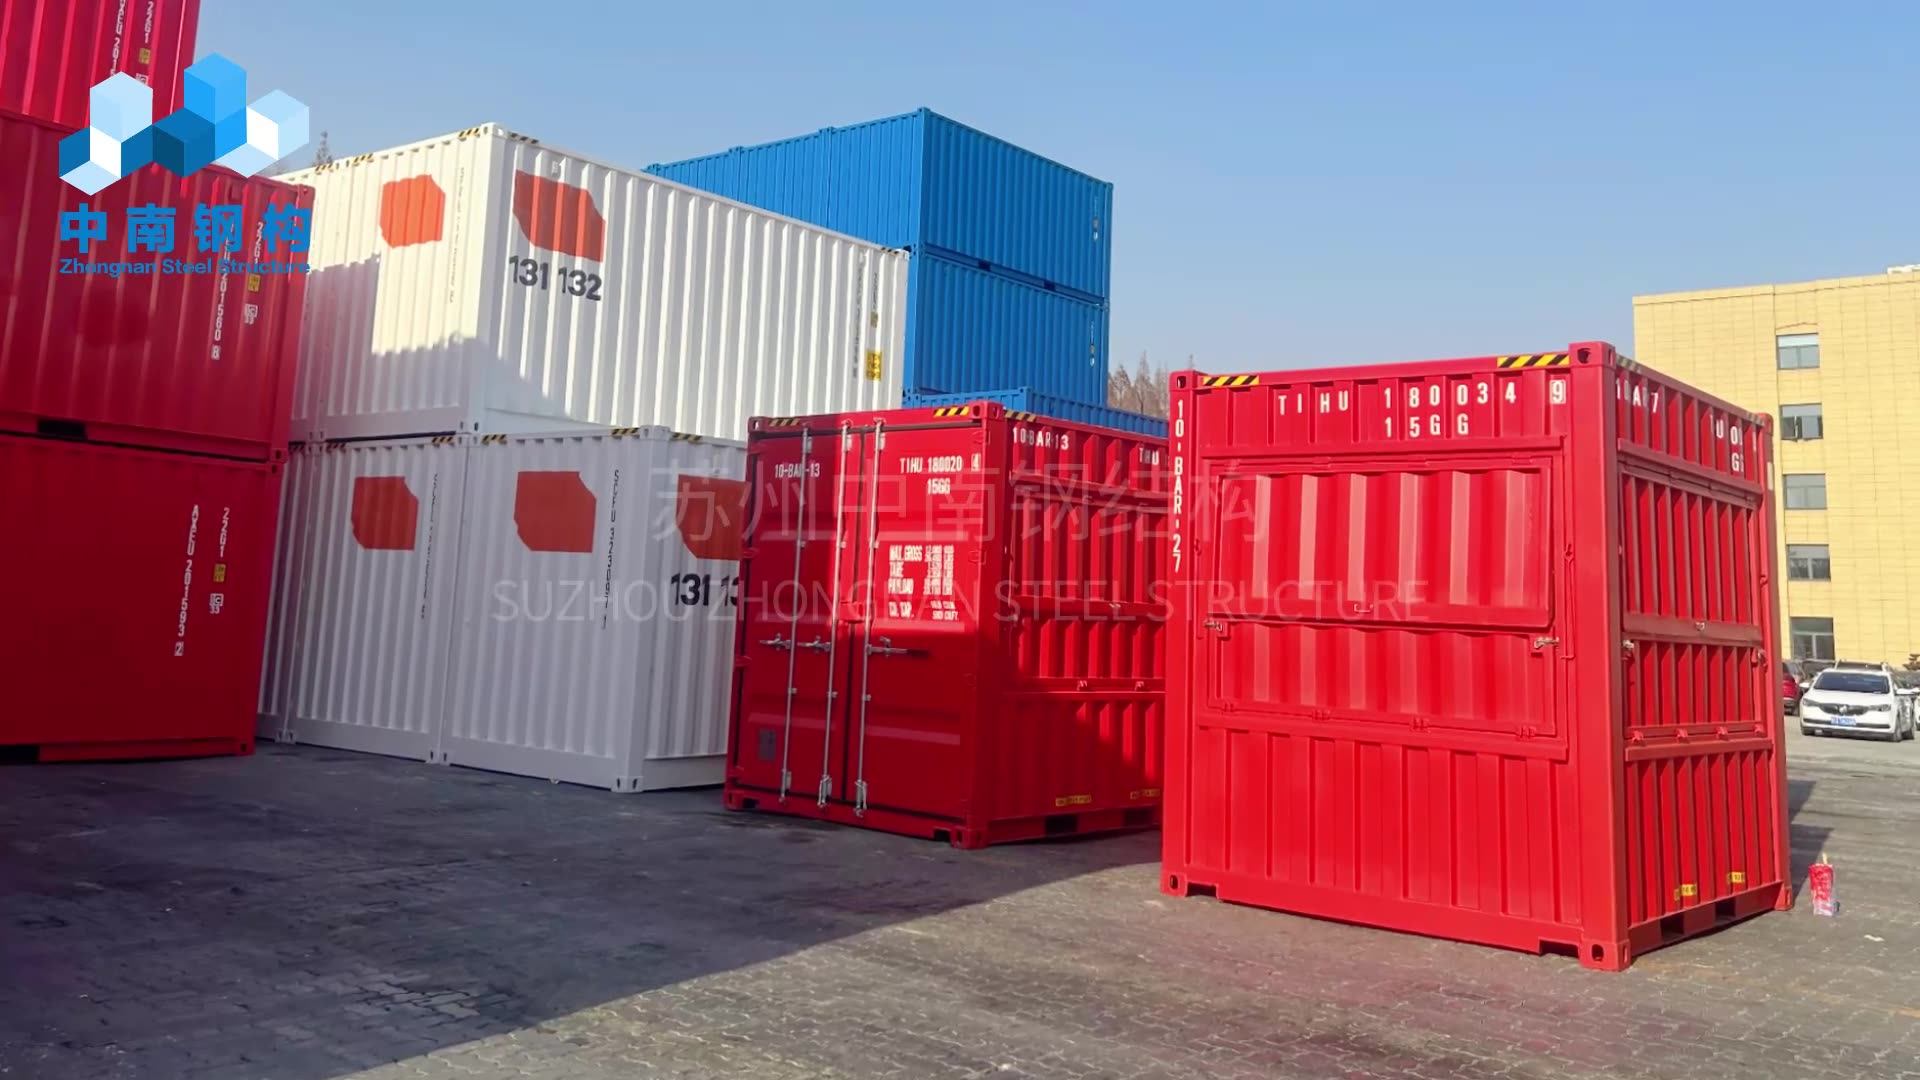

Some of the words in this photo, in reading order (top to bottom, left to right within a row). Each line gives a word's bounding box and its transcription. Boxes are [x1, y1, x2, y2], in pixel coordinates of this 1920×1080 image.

[509, 255, 549, 290] 131
[558, 266, 603, 301] 132
[1278, 390, 1349, 415] TIHU
[1384, 381, 1517, 409] 180034
[1385, 413, 1469, 438] 15GG
[900, 457, 923, 474] TIHU
[927, 455, 962, 474] 180020
[670, 572, 711, 606] 131
